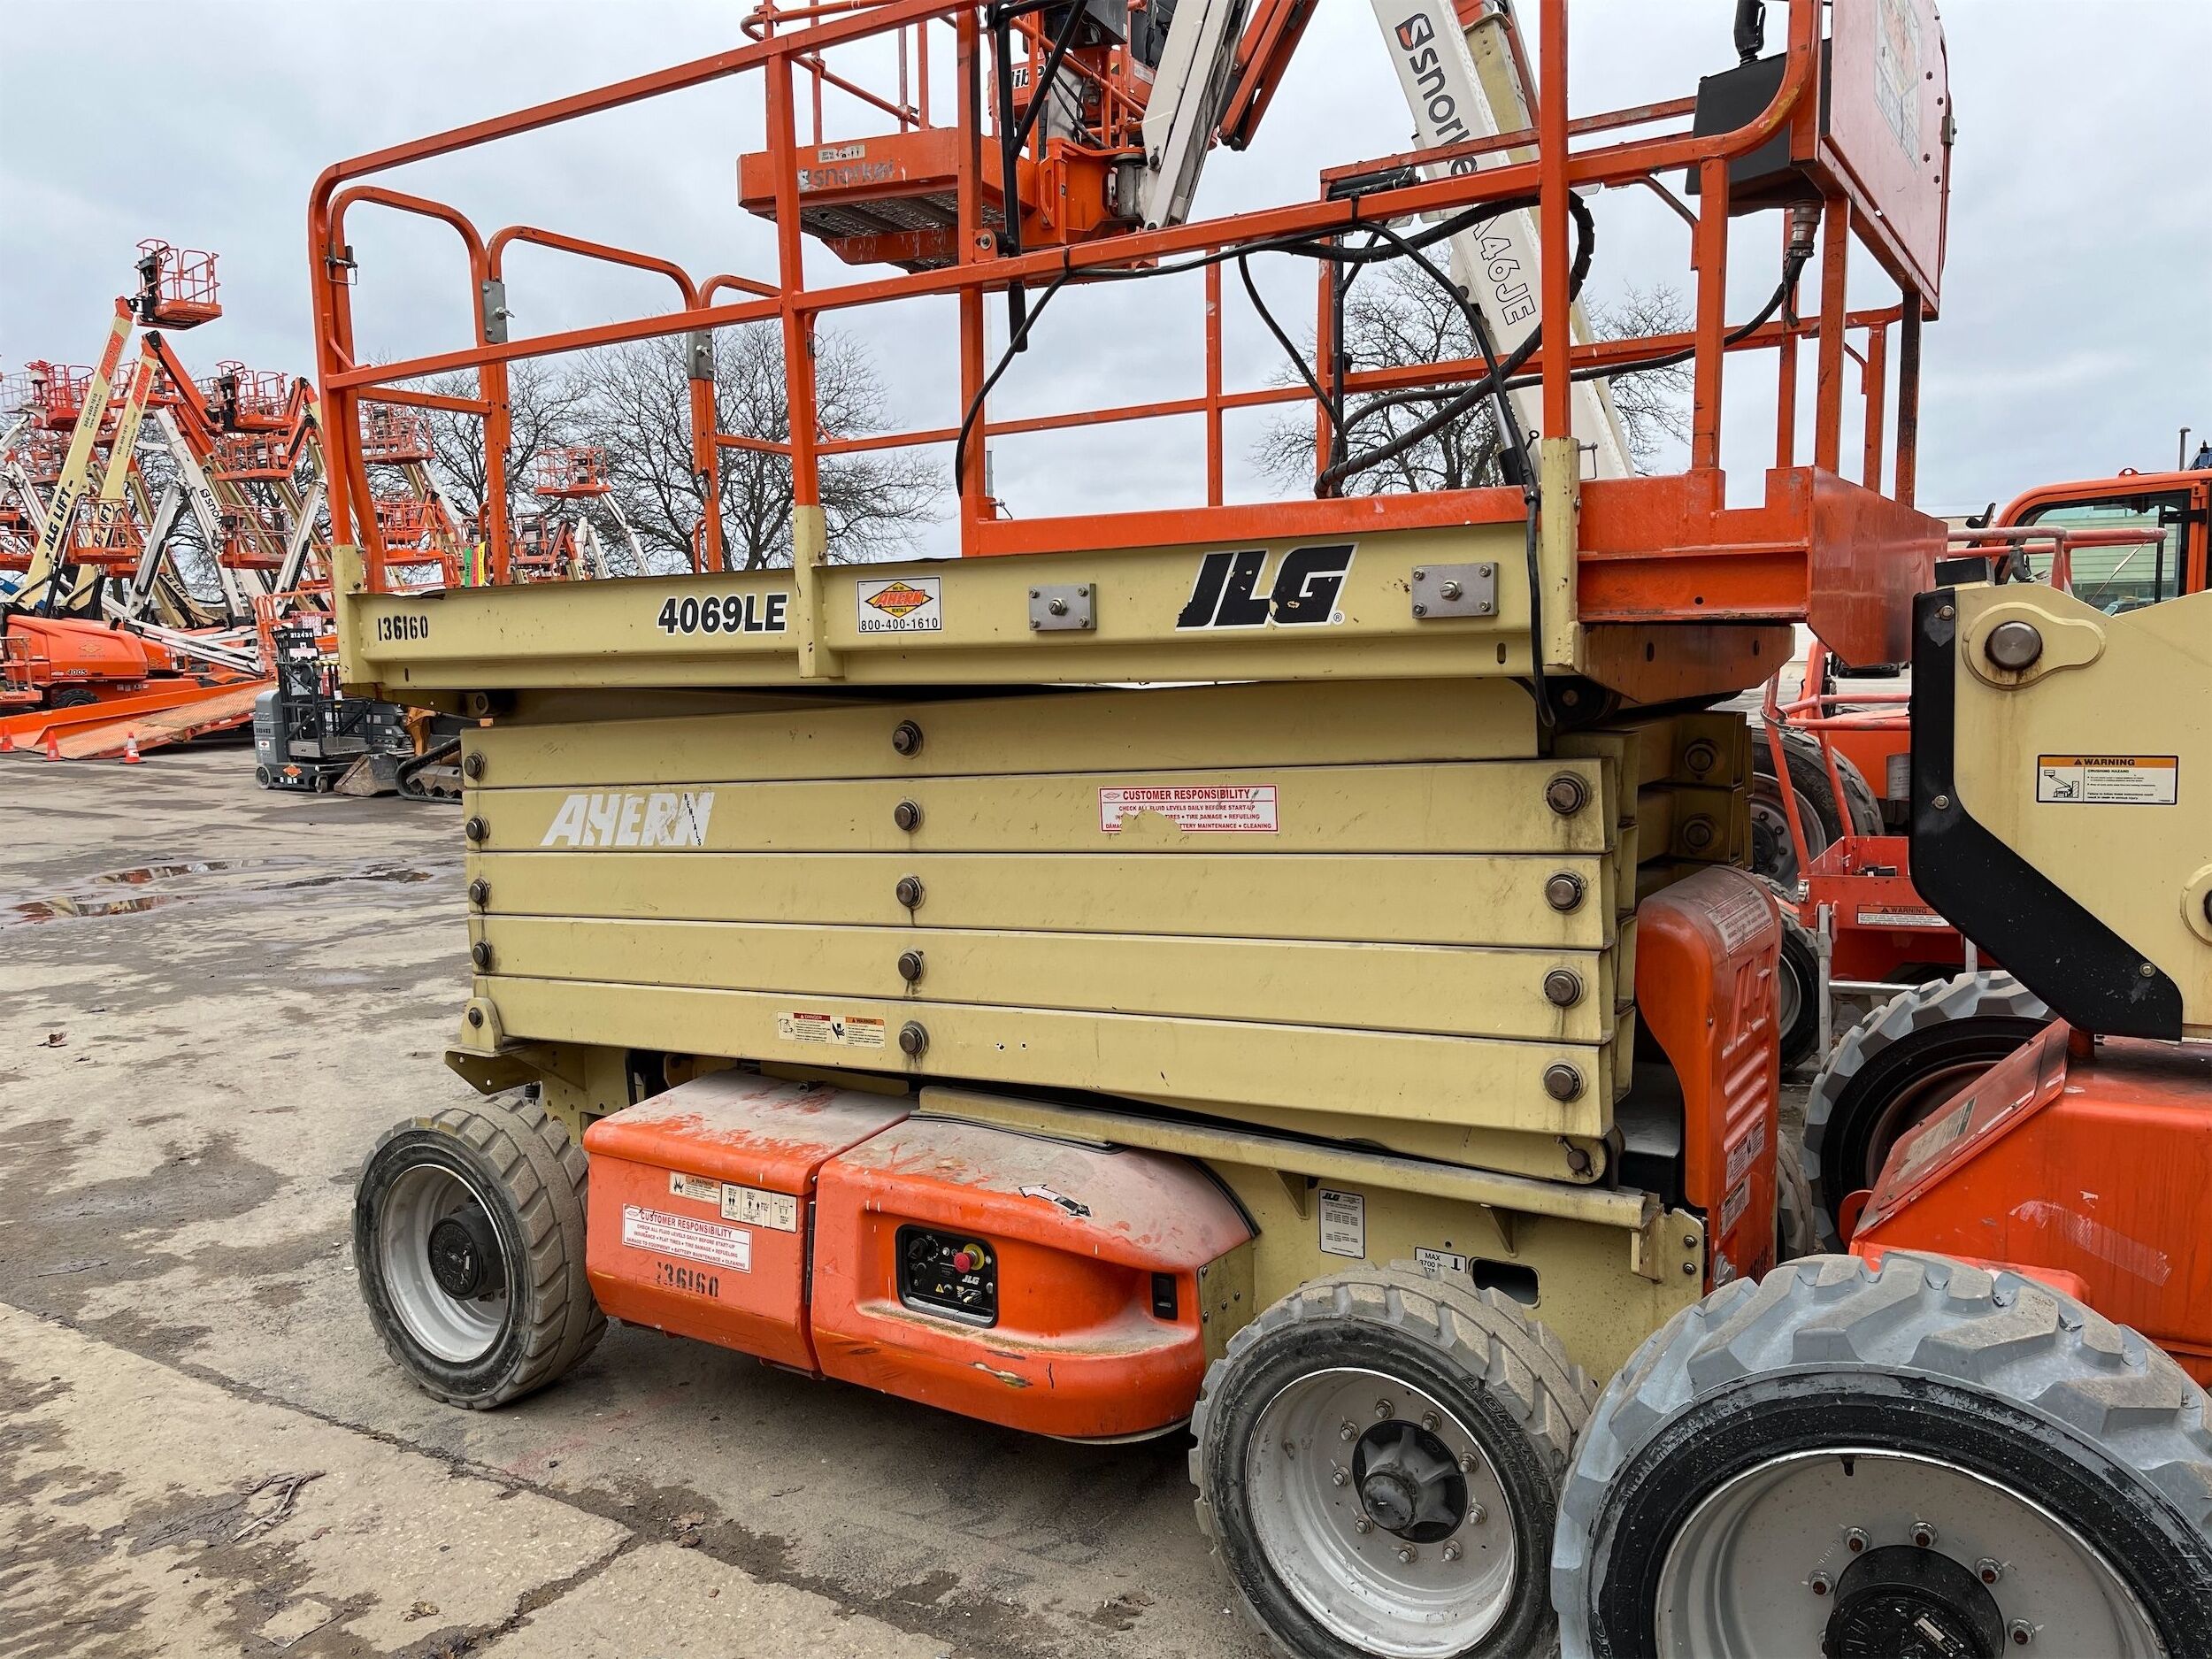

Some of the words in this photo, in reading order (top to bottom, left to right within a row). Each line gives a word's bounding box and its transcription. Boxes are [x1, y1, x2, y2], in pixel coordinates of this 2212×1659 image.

[1409, 47, 1478, 177] snore
[44, 522, 58, 551] JLG
[53, 487, 72, 520] LIFT
[873, 590, 924, 606] AHERN
[1175, 541, 1359, 632] JLG
[378, 614, 429, 641] 136160
[657, 592, 788, 637] 4069LE
[861, 618, 938, 631] 800-400-1610
[1123, 790, 1171, 800] CUSTOMER
[1174, 788, 1250, 800] RESPONSIBILITY
[539, 793, 715, 846] AHERN
[684, 793, 702, 846] RENTALS
[1322, 1192, 1340, 1202] JLG
[641, 1211, 676, 1226] CUSTOMER
[677, 1219, 733, 1239] RESPONSIBILITY
[962, 1274, 980, 1285] JLG
